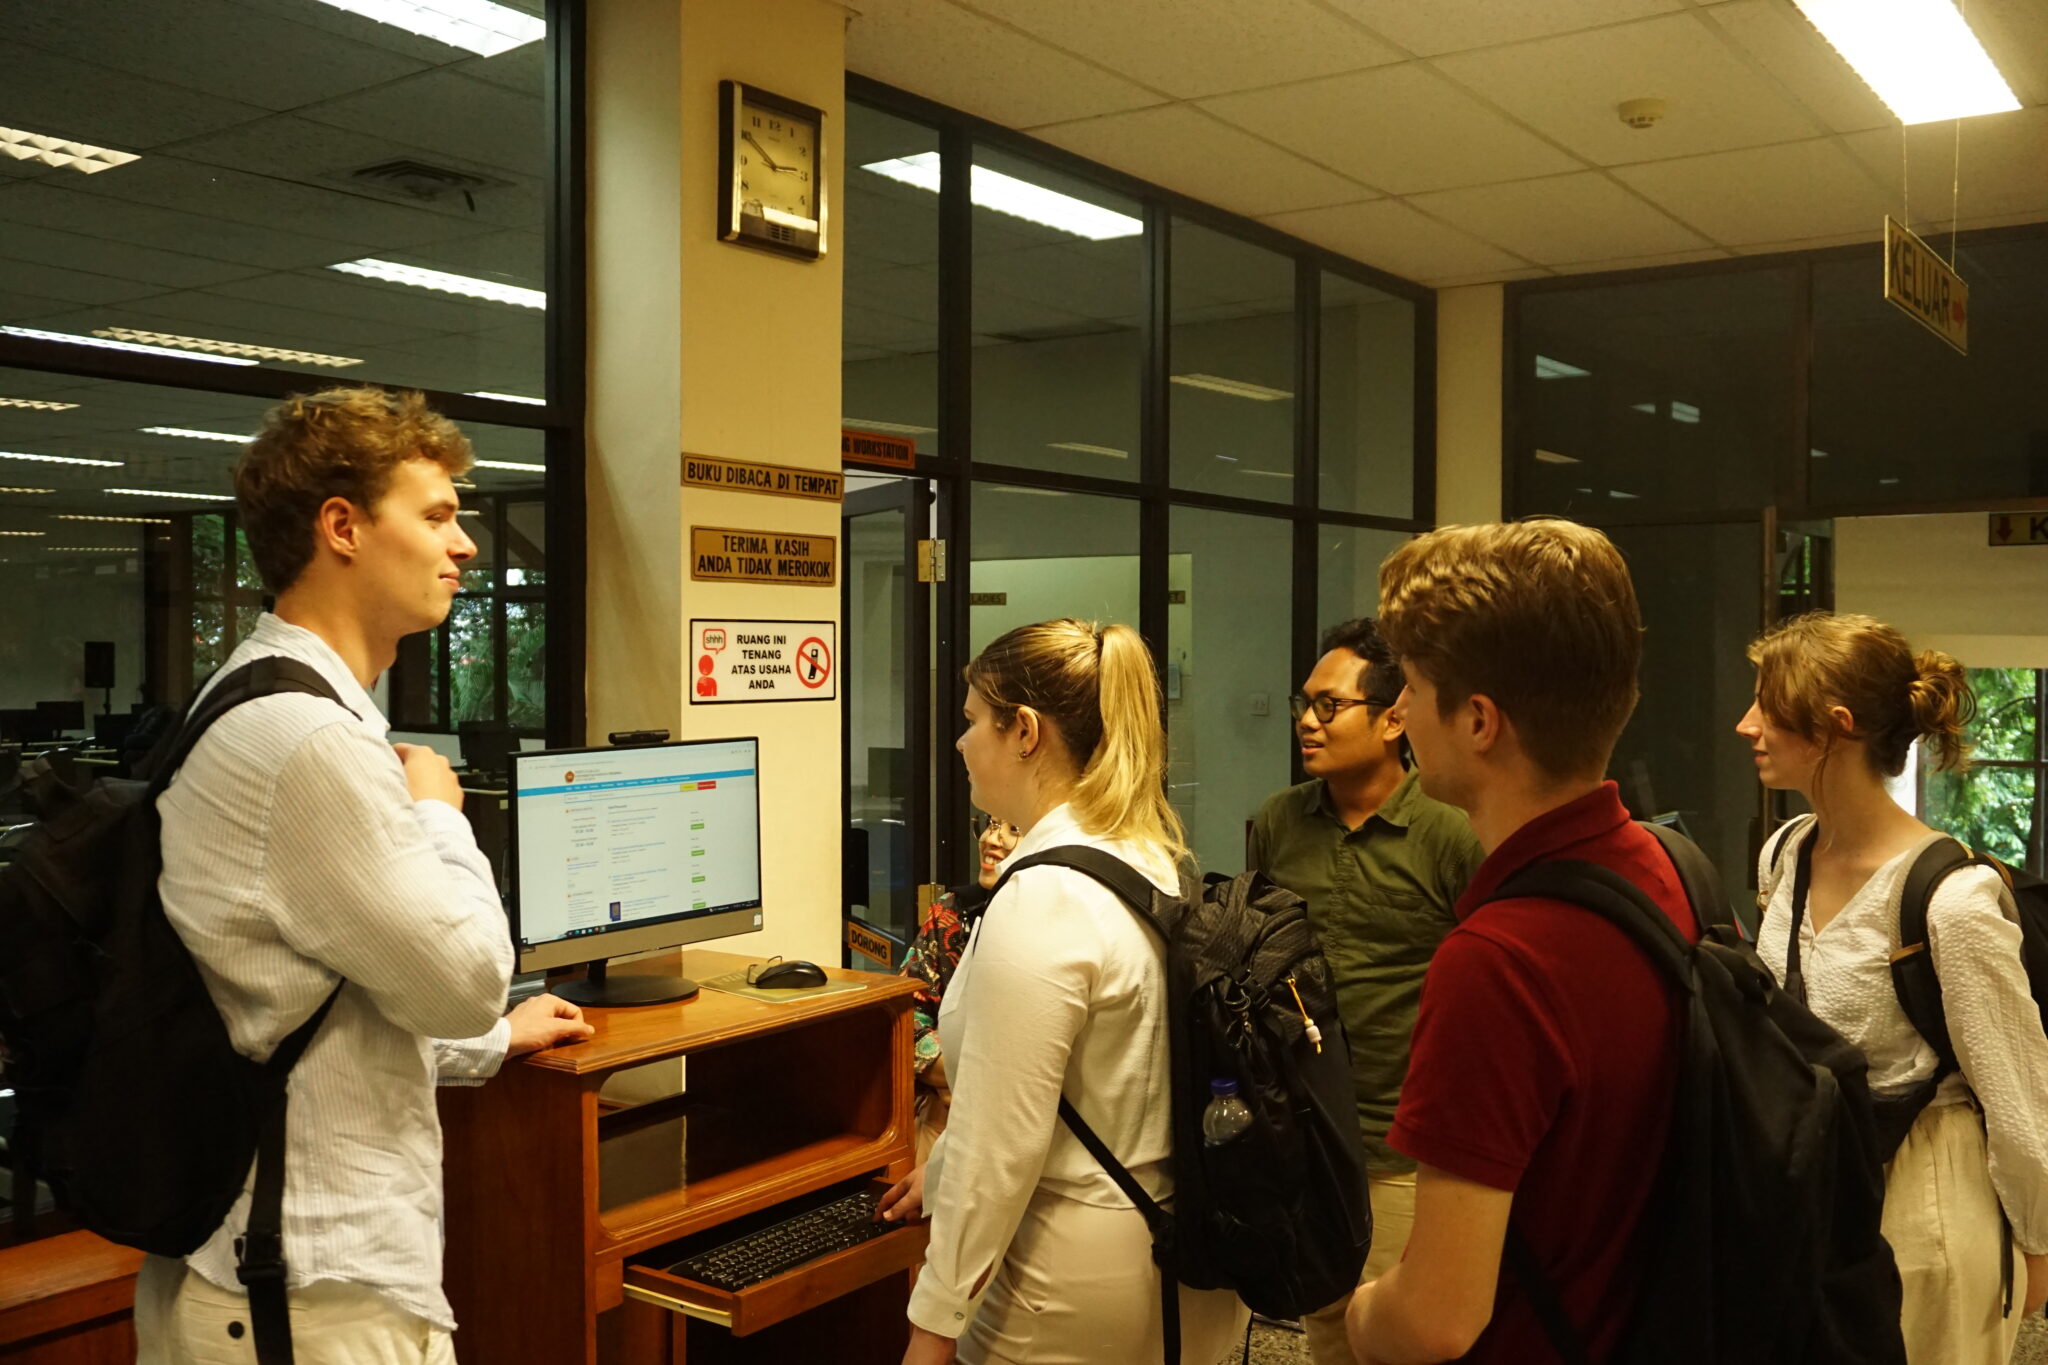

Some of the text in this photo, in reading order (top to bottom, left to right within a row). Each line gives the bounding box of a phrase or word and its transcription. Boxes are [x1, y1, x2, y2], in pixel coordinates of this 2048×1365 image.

[769, 119, 782, 132] 12
[1890, 229, 1950, 332] KELUAR
[854, 439, 908, 460] WORKSTATION
[687, 462, 838, 495] BUKU DIBACA DI TEMPAT
[723, 535, 810, 556] TERIMA KASIH
[697, 555, 831, 578] ANDA TIDAK MEROKOK
[706, 634, 723, 644] shhh
[736, 635, 786, 645] RUANG INI
[742, 650, 782, 660] TENANG
[731, 665, 792, 675] ATAS USAHA
[748, 680, 775, 690] ANDA
[852, 930, 887, 959] DORONG
